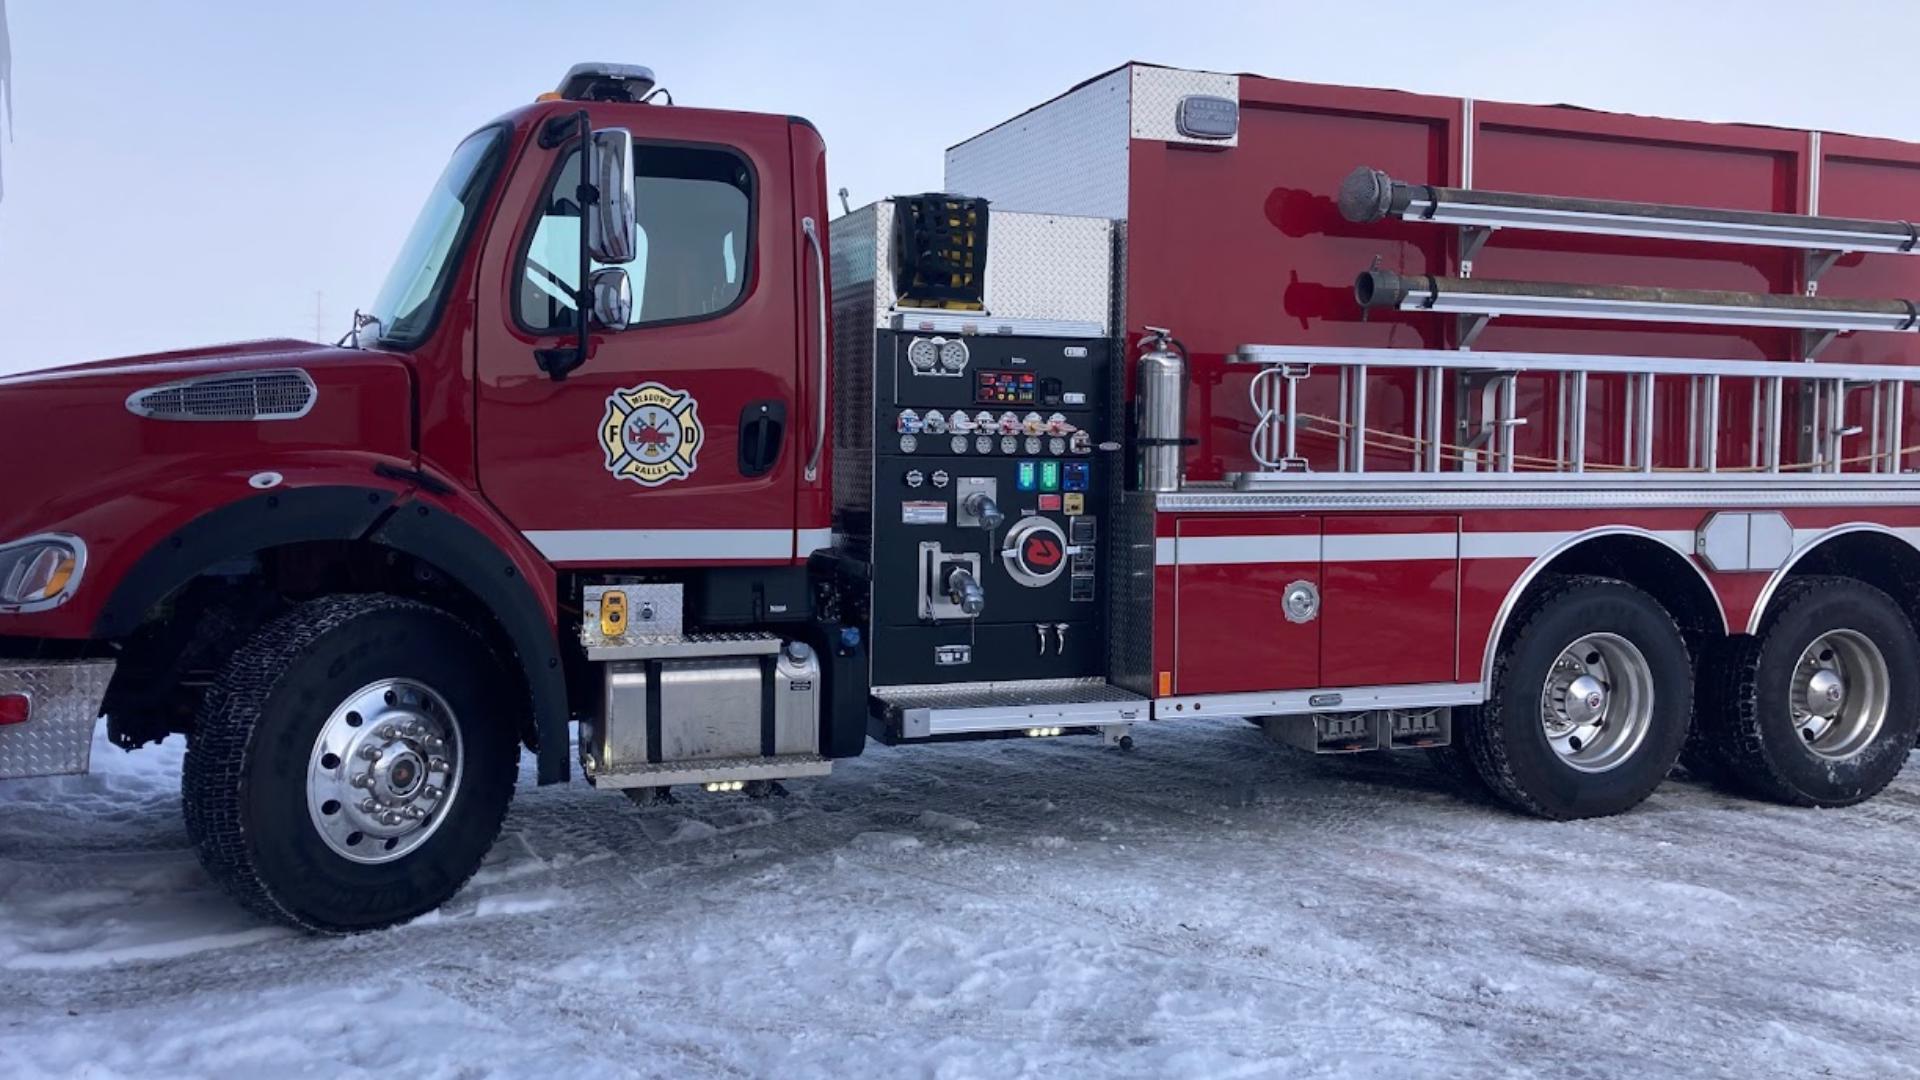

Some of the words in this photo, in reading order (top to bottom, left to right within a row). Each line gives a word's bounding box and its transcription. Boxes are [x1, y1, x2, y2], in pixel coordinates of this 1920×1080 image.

[631, 394, 672, 406] MEADOWS
[610, 425, 619, 443] F
[685, 426, 695, 444] D
[634, 464, 669, 475] VALLEY
